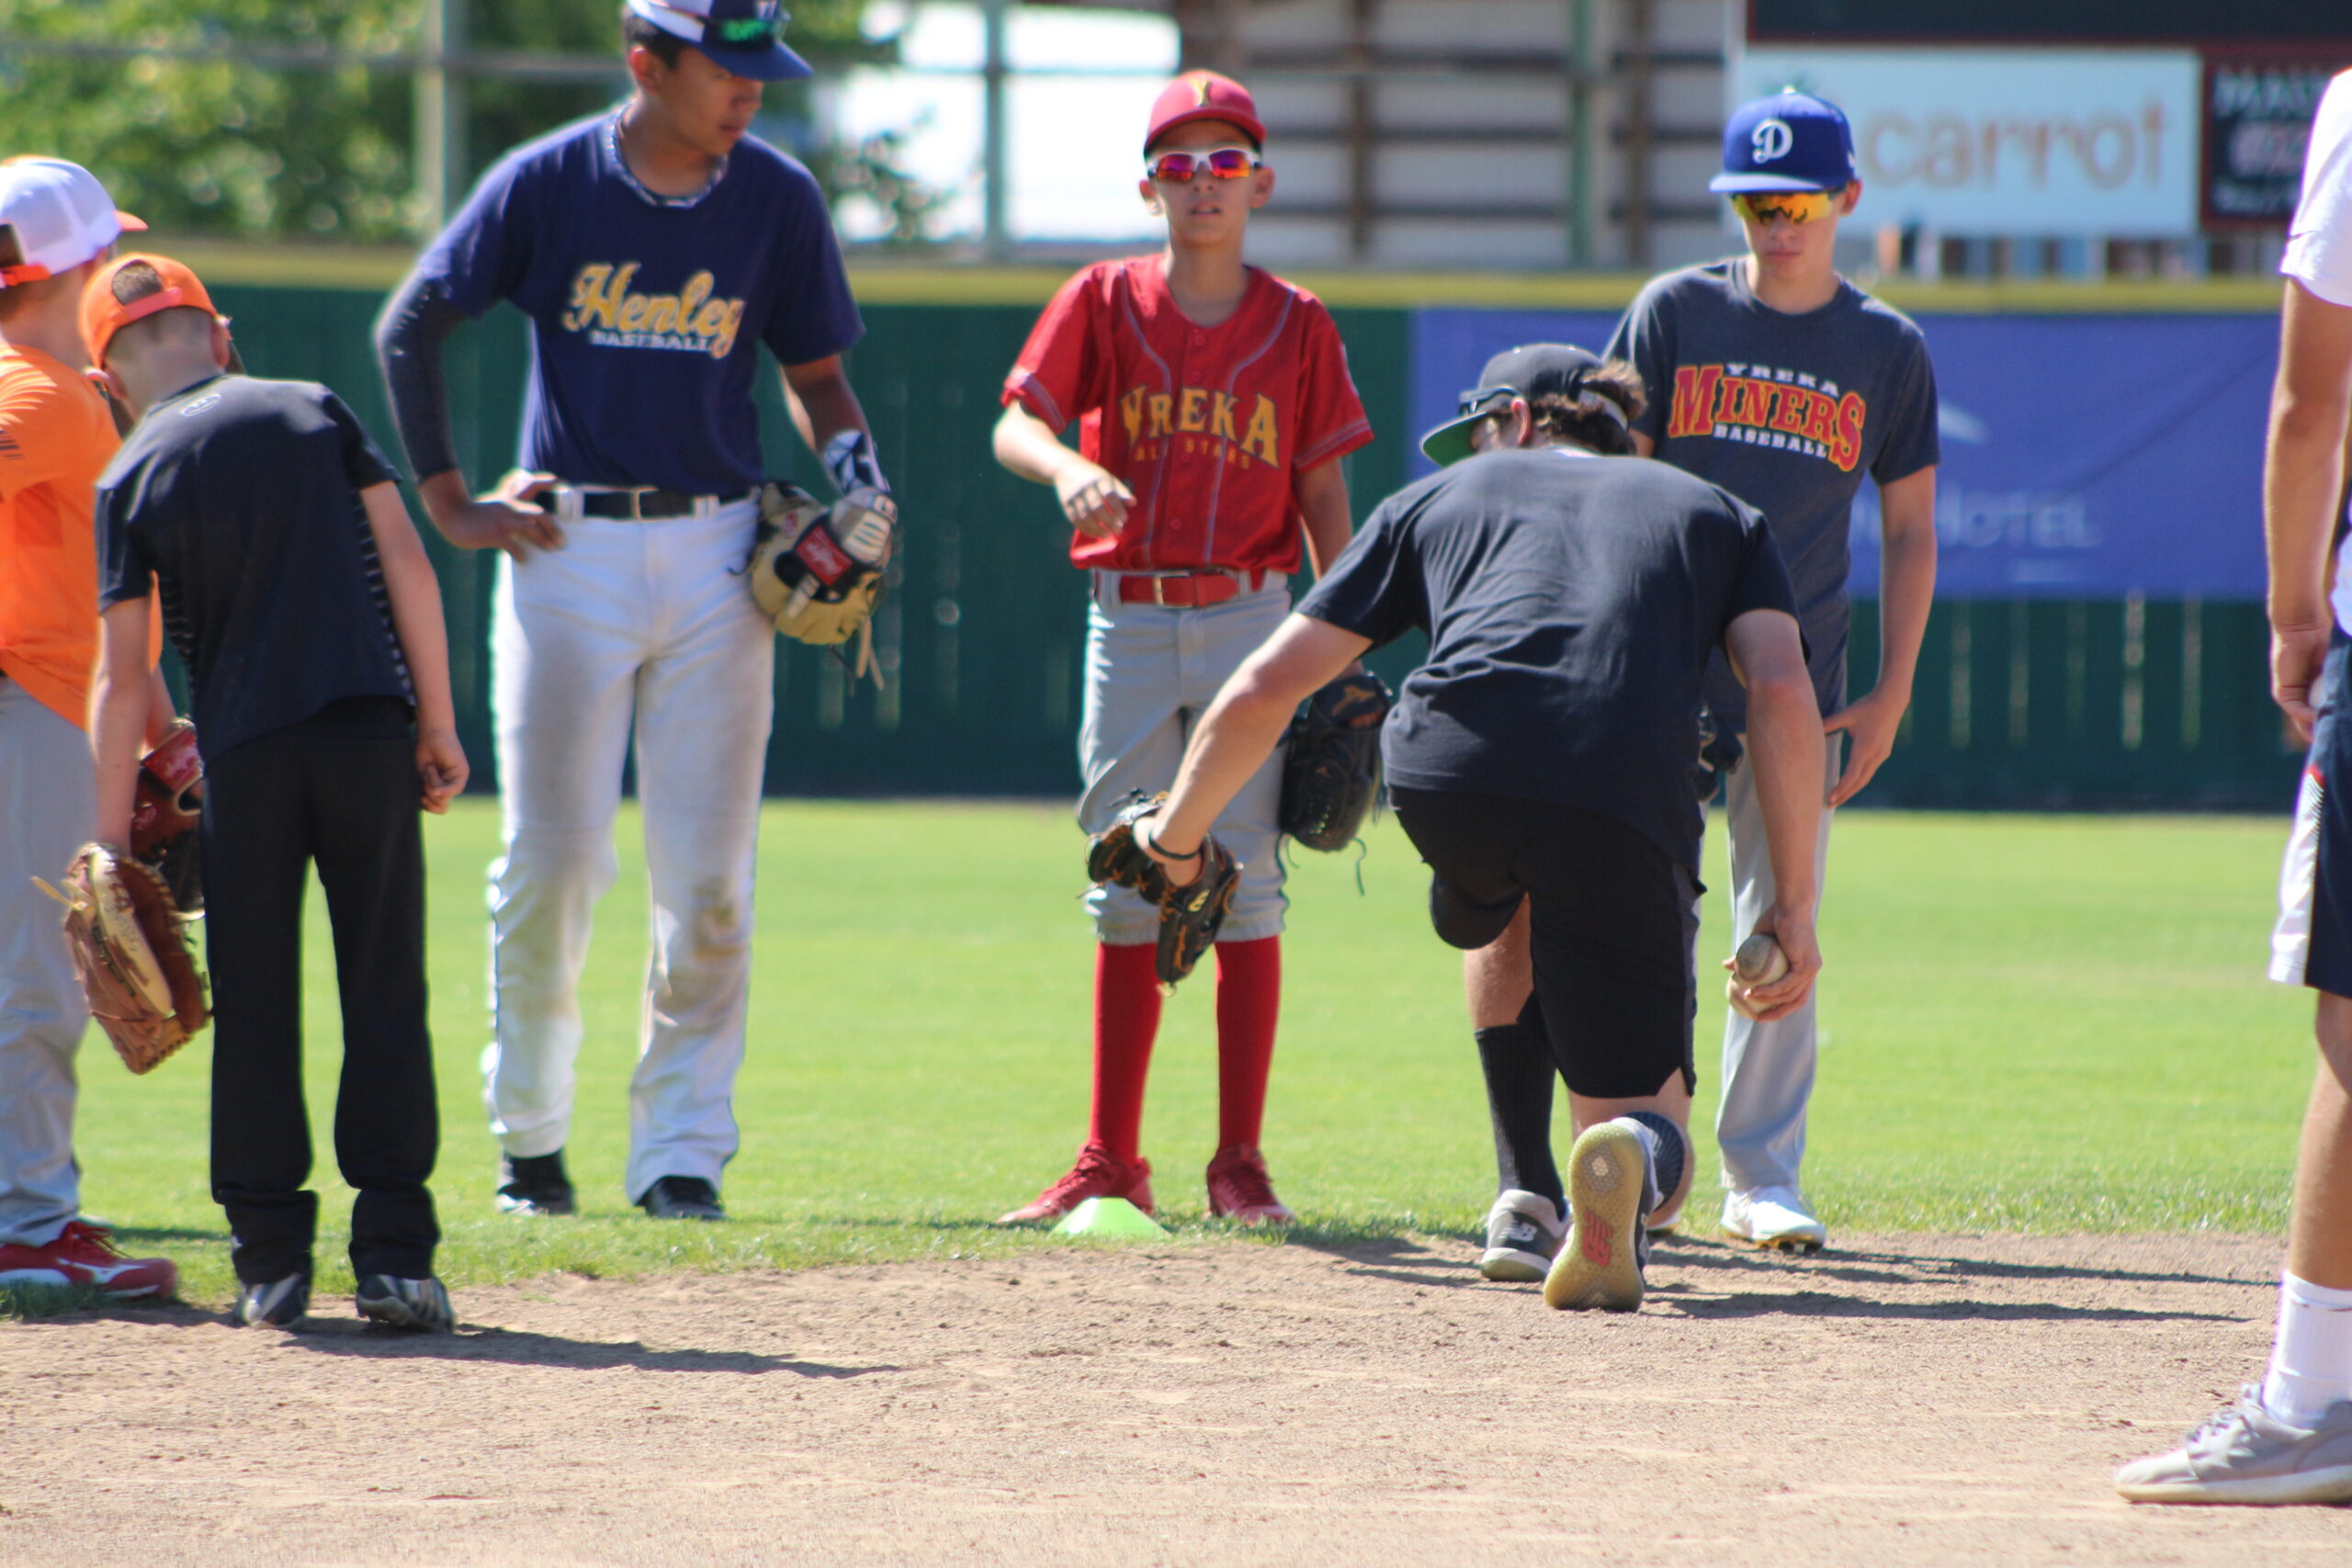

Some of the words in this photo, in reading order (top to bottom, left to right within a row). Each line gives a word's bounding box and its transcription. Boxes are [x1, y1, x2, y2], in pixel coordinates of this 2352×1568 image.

[1751, 118, 1793, 164] D
[1862, 96, 2174, 190] carrot
[562, 262, 745, 360] Henley
[1725, 362, 1840, 398] YREKA
[1667, 364, 1867, 473] MINERS
[1712, 422, 1828, 459] BASEBALL
